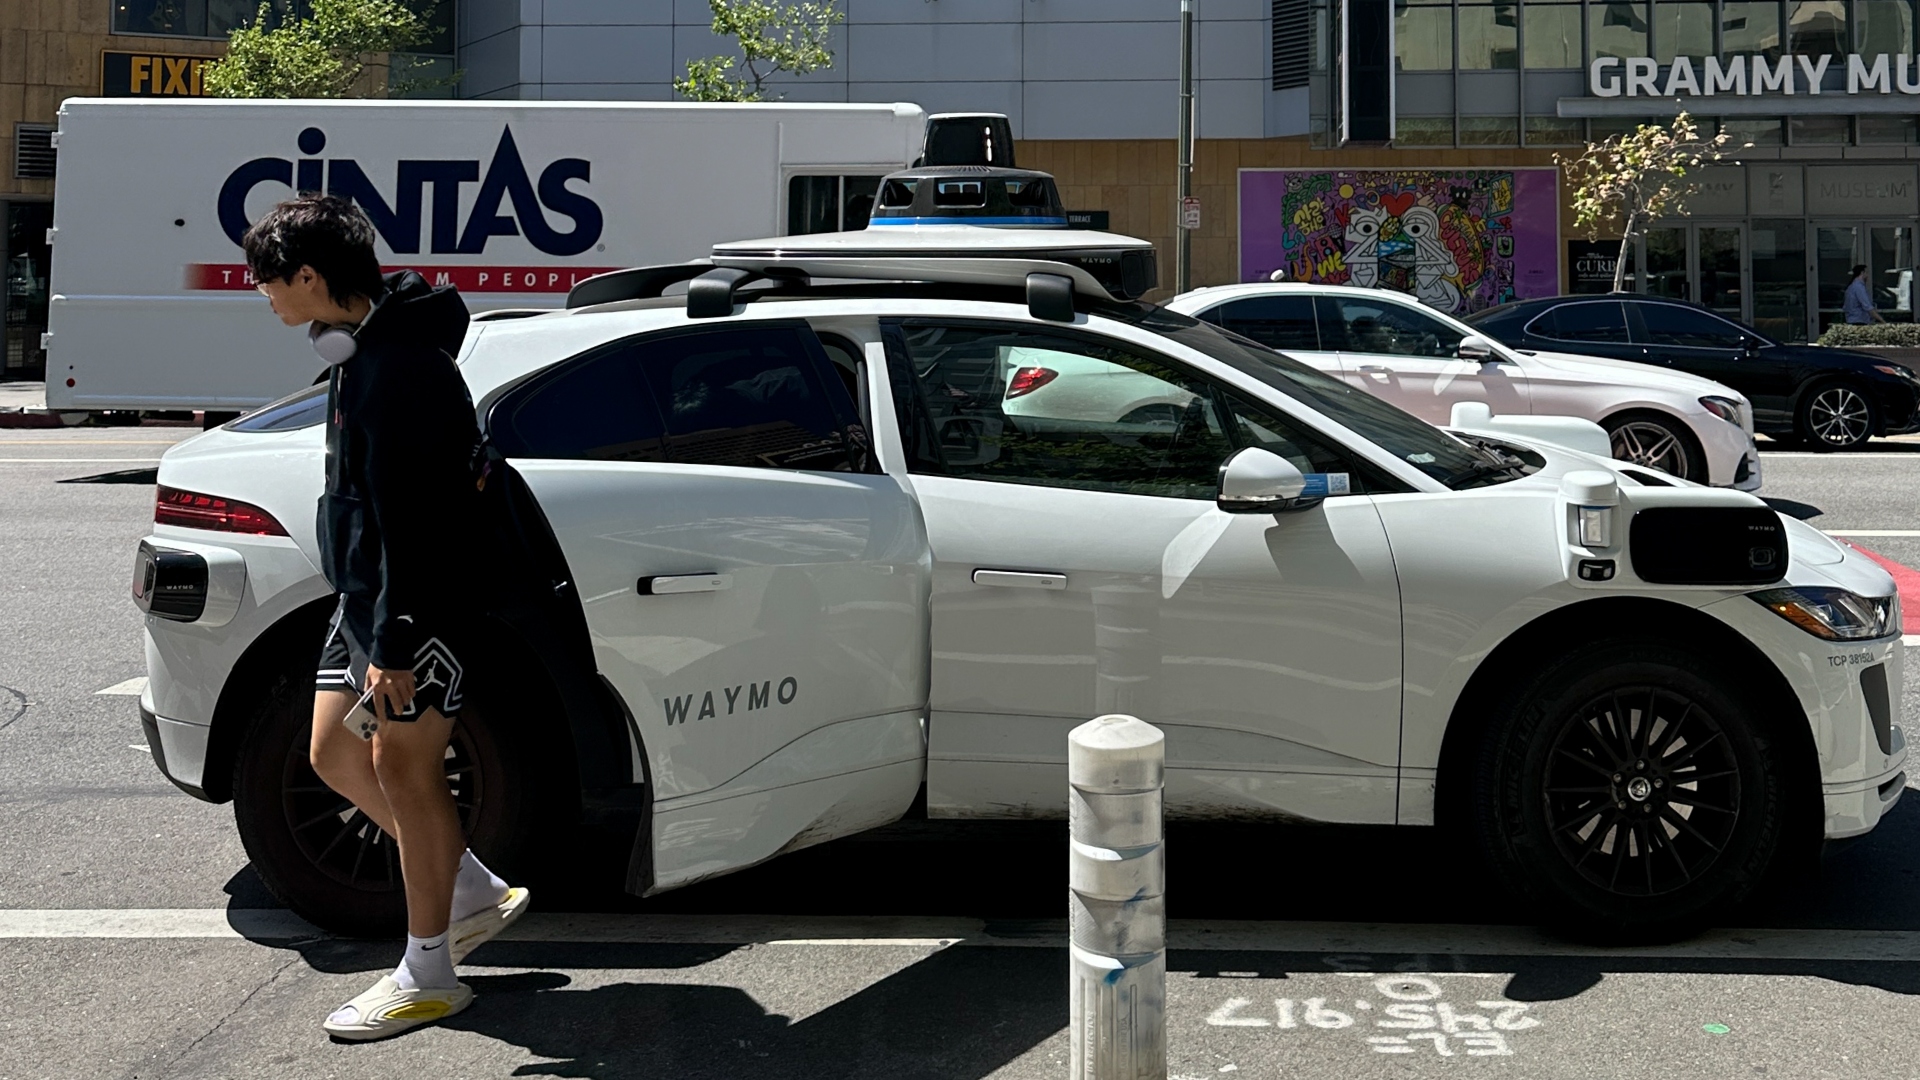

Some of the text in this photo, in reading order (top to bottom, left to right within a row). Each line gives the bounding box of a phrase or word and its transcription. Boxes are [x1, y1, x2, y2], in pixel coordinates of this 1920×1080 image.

[130, 55, 213, 96] FIXI
[1589, 54, 1833, 98] GRAMMY
[1317, 250, 1347, 279] WE
[1576, 260, 1617, 272] CURB
[478, 272, 603, 287] PEOPL
[1827, 655, 1847, 667] TCP
[663, 676, 798, 726] WAYMO
